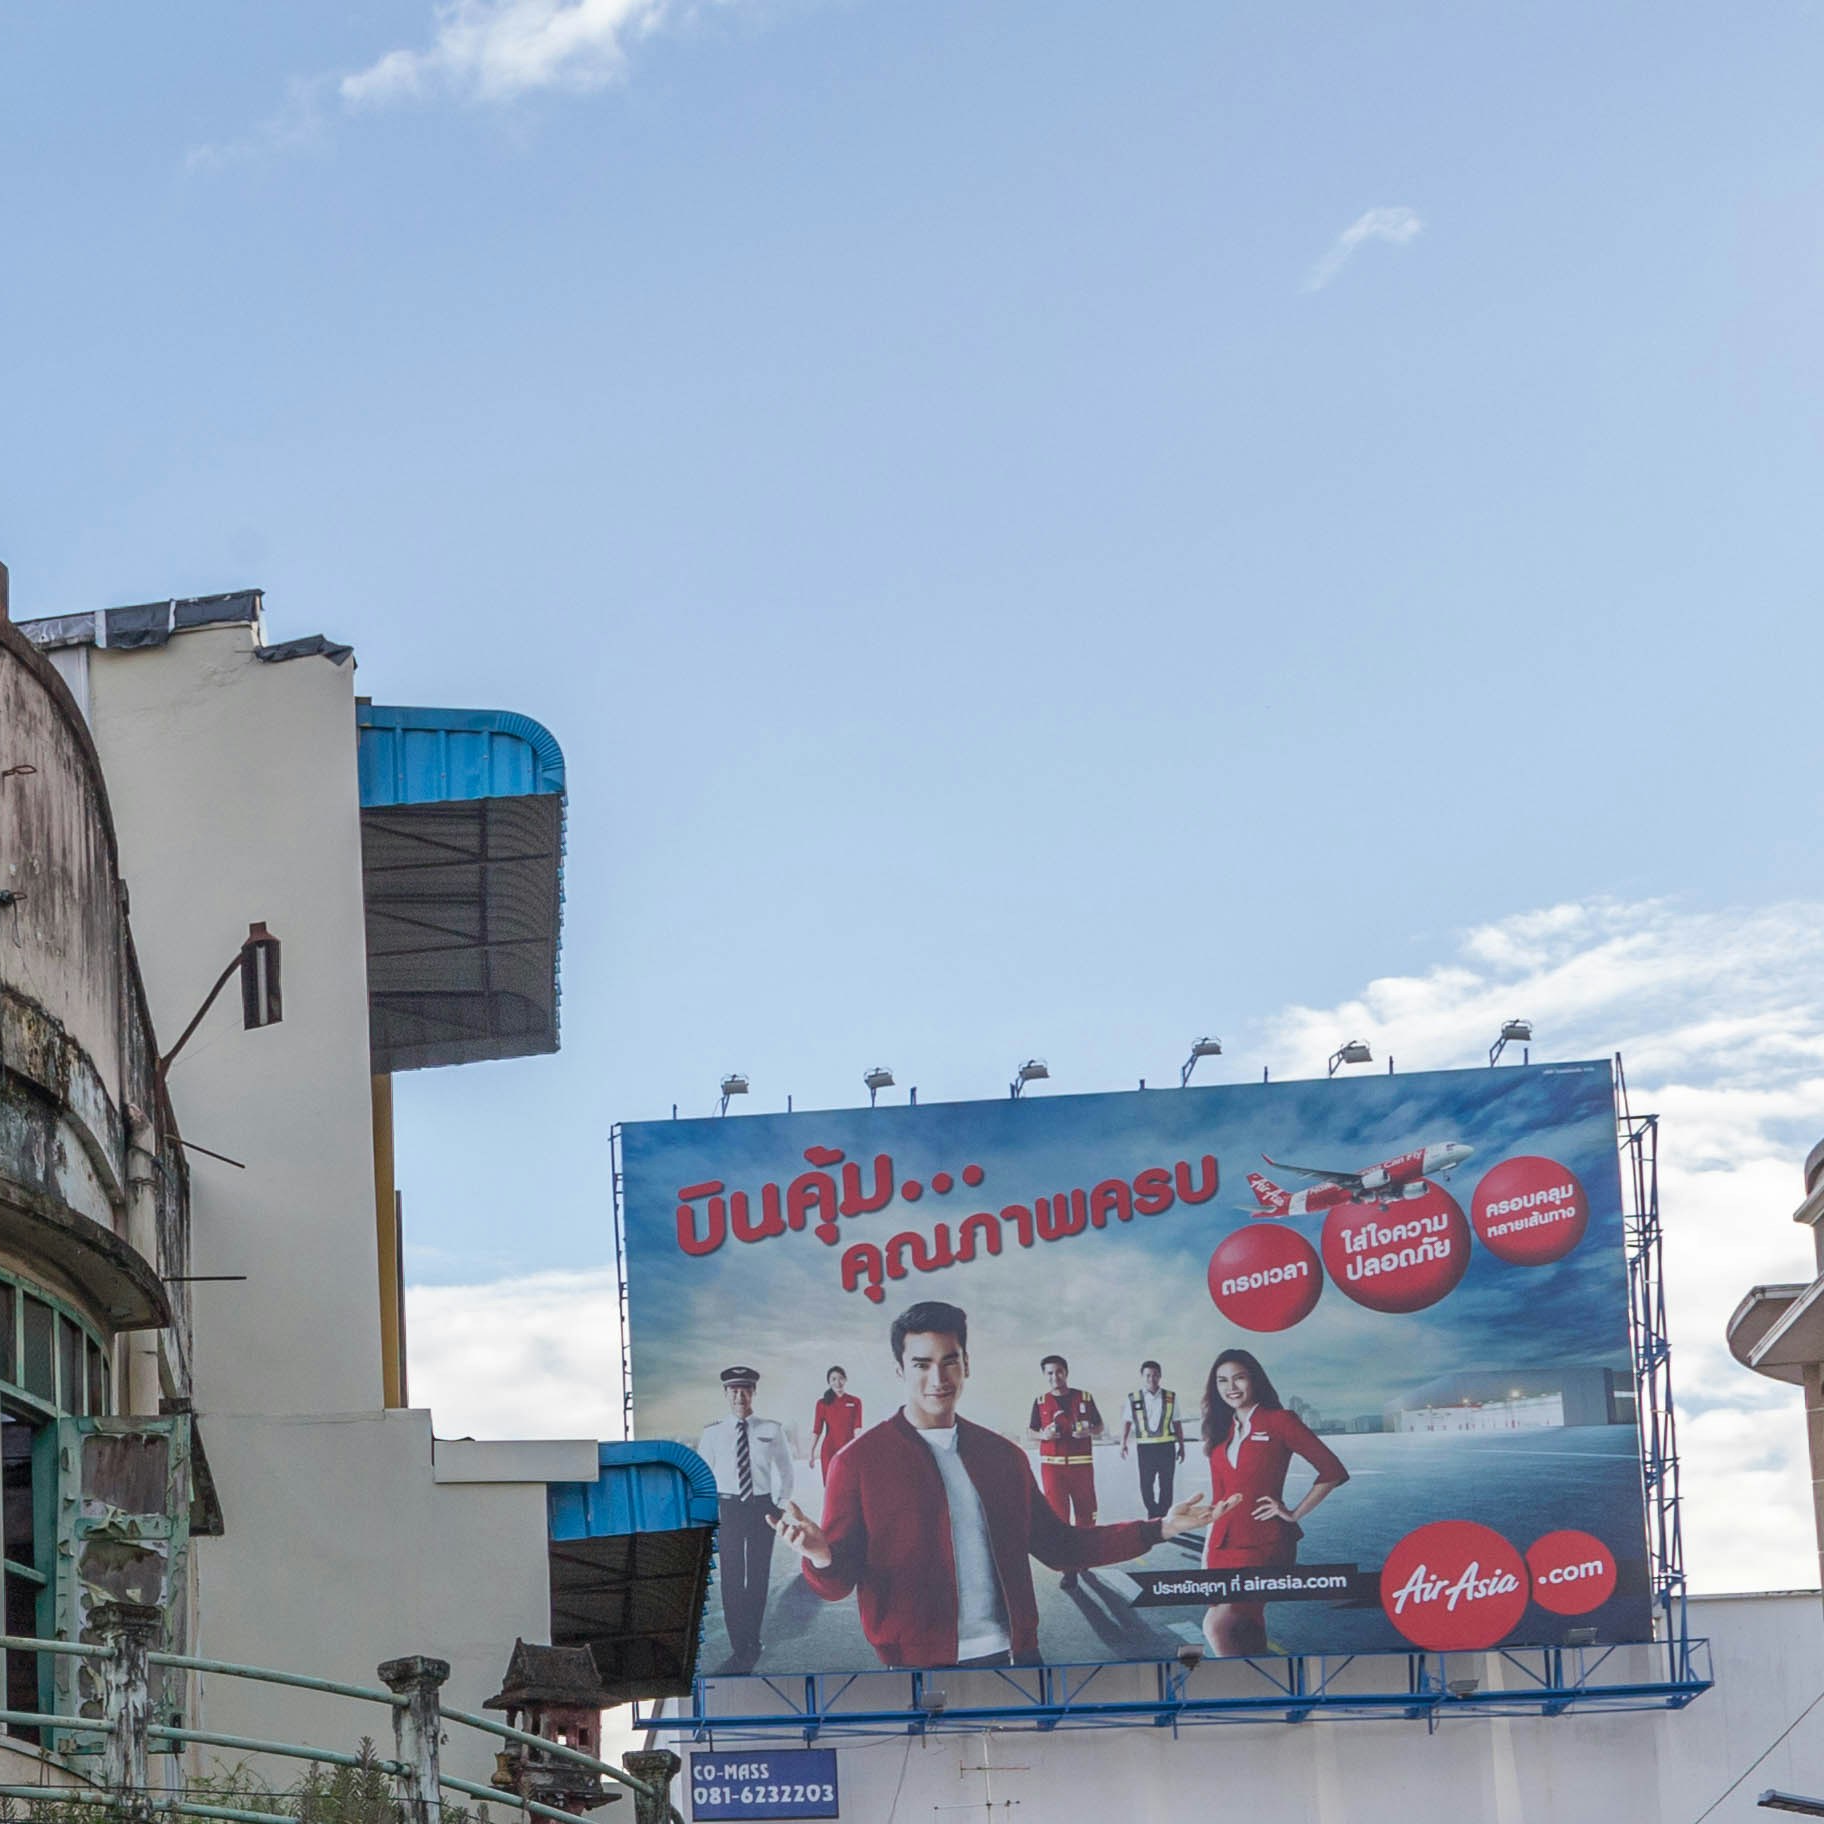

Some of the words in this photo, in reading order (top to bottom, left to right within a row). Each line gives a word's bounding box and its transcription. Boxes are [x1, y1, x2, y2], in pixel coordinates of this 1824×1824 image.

[677, 1146, 984, 1257] บินคุ้ม...
[1485, 1184, 1574, 1218] ครอบคลุม
[841, 1154, 1220, 1302] คุณภาพครบ
[1340, 1213, 1449, 1255] ใส่ใจความ
[1486, 1204, 1576, 1238] หลายเส้นทาง
[1346, 1236, 1451, 1281] ปลอดภัย
[1221, 1260, 1309, 1296] ตรงเวลา
[1152, 1569, 1227, 1598] ประหยัดสุดๆ
[1230, 1571, 1241, 1594] ที่
[1243, 1573, 1347, 1592] airasia.com
[1538, 1560, 1604, 1585] .com
[693, 1764, 770, 1781] CO-MASS
[693, 1784, 834, 1805] 081-6232203
